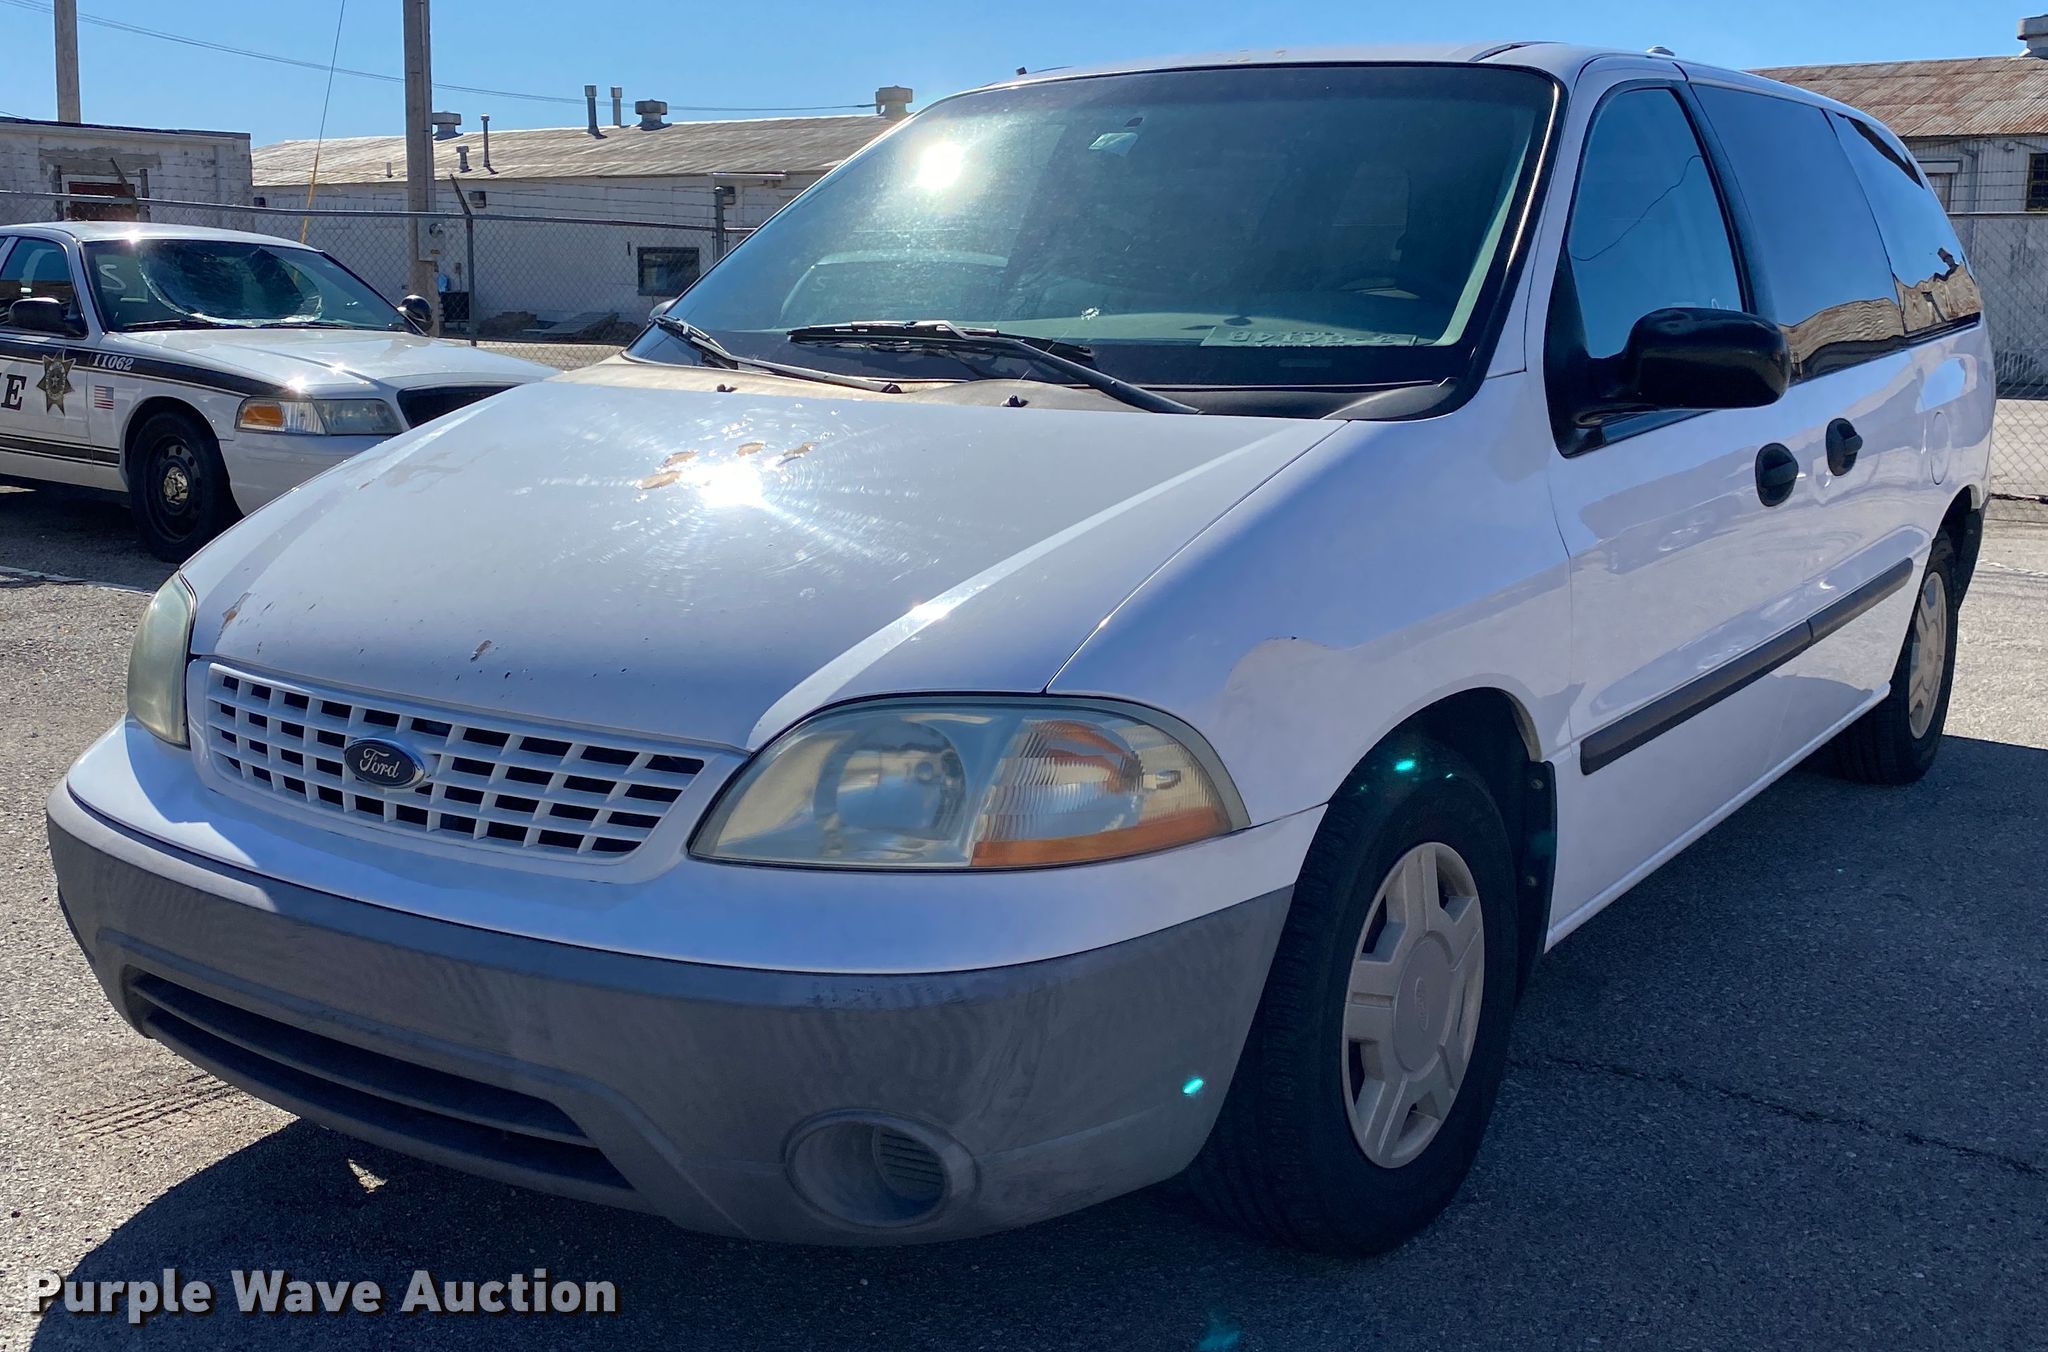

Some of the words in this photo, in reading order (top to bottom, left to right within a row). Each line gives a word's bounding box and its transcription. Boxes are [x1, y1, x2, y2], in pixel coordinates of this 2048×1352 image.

[92, 353, 136, 371] 11062
[0, 372, 28, 411] E
[360, 748, 400, 778] Ford
